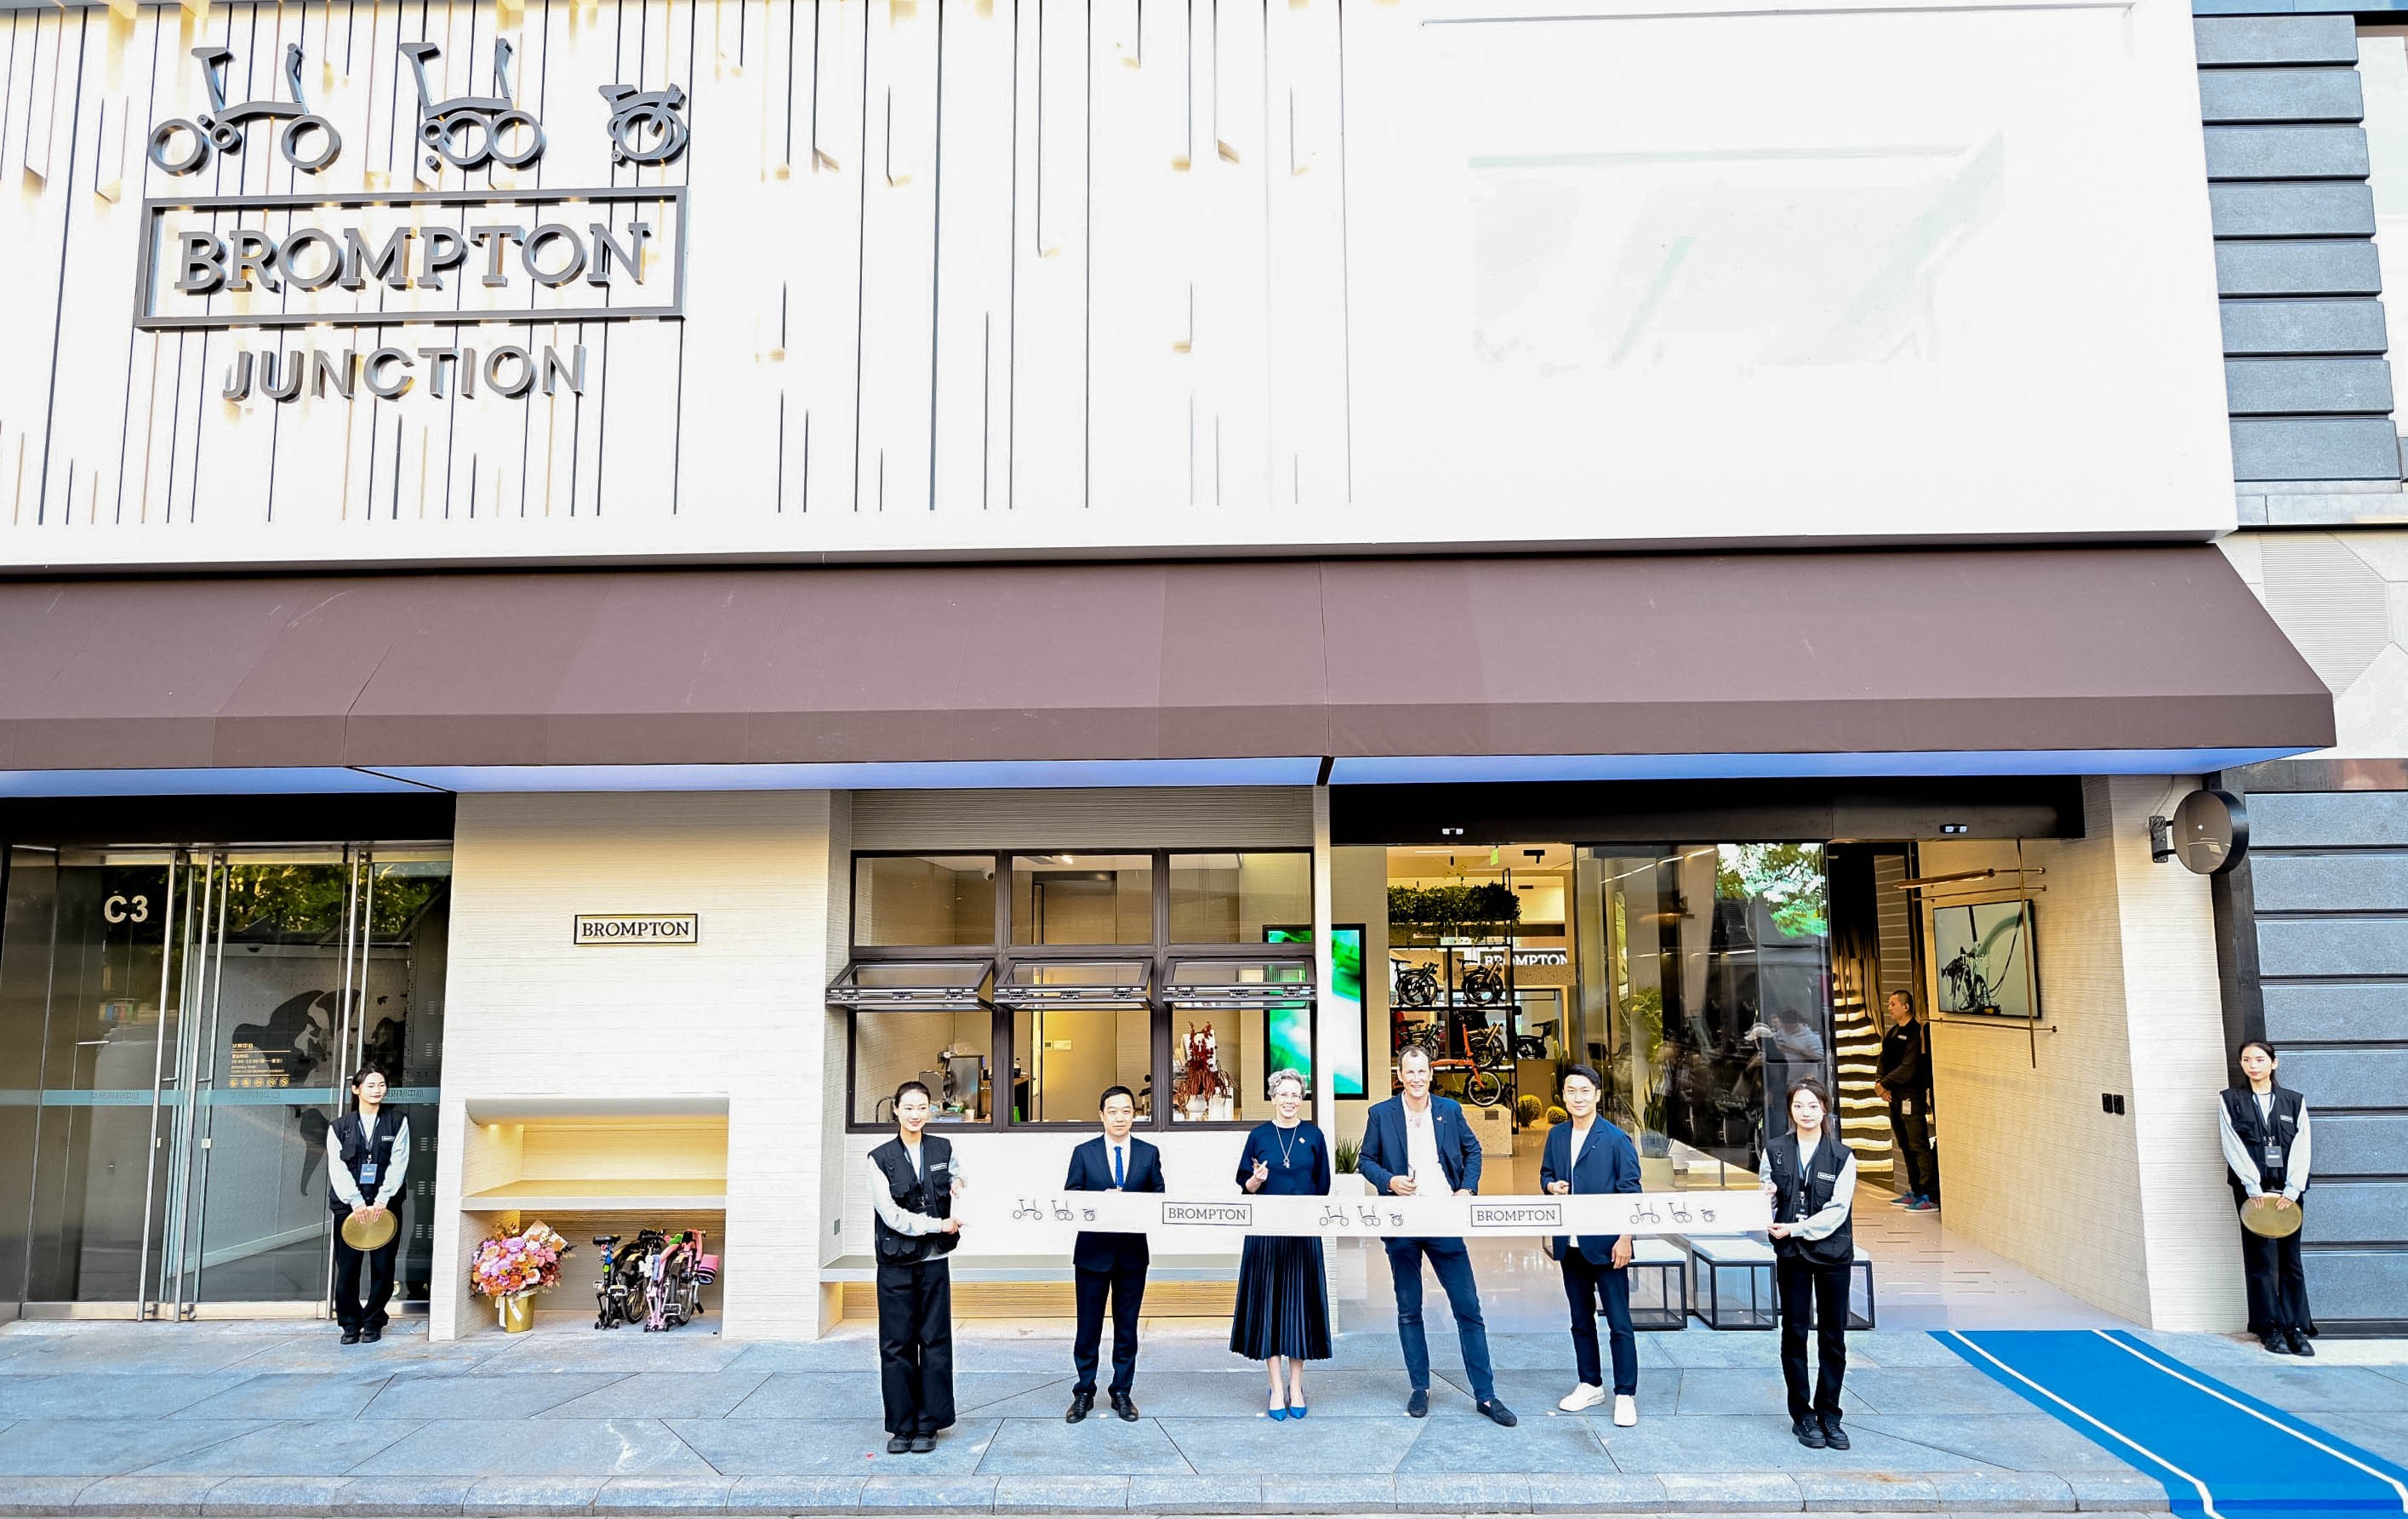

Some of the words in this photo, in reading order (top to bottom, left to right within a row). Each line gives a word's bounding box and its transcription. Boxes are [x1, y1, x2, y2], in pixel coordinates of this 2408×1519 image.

[174, 221, 652, 294] BROMPTON
[222, 343, 586, 402] JUNCTION
[104, 894, 149, 923] C3
[582, 921, 690, 937] BROMPTON
[1484, 953, 1568, 966] BRMPTON
[1168, 1208, 1247, 1220] BROMPTON
[1476, 1209, 1555, 1222] BROMPTON
